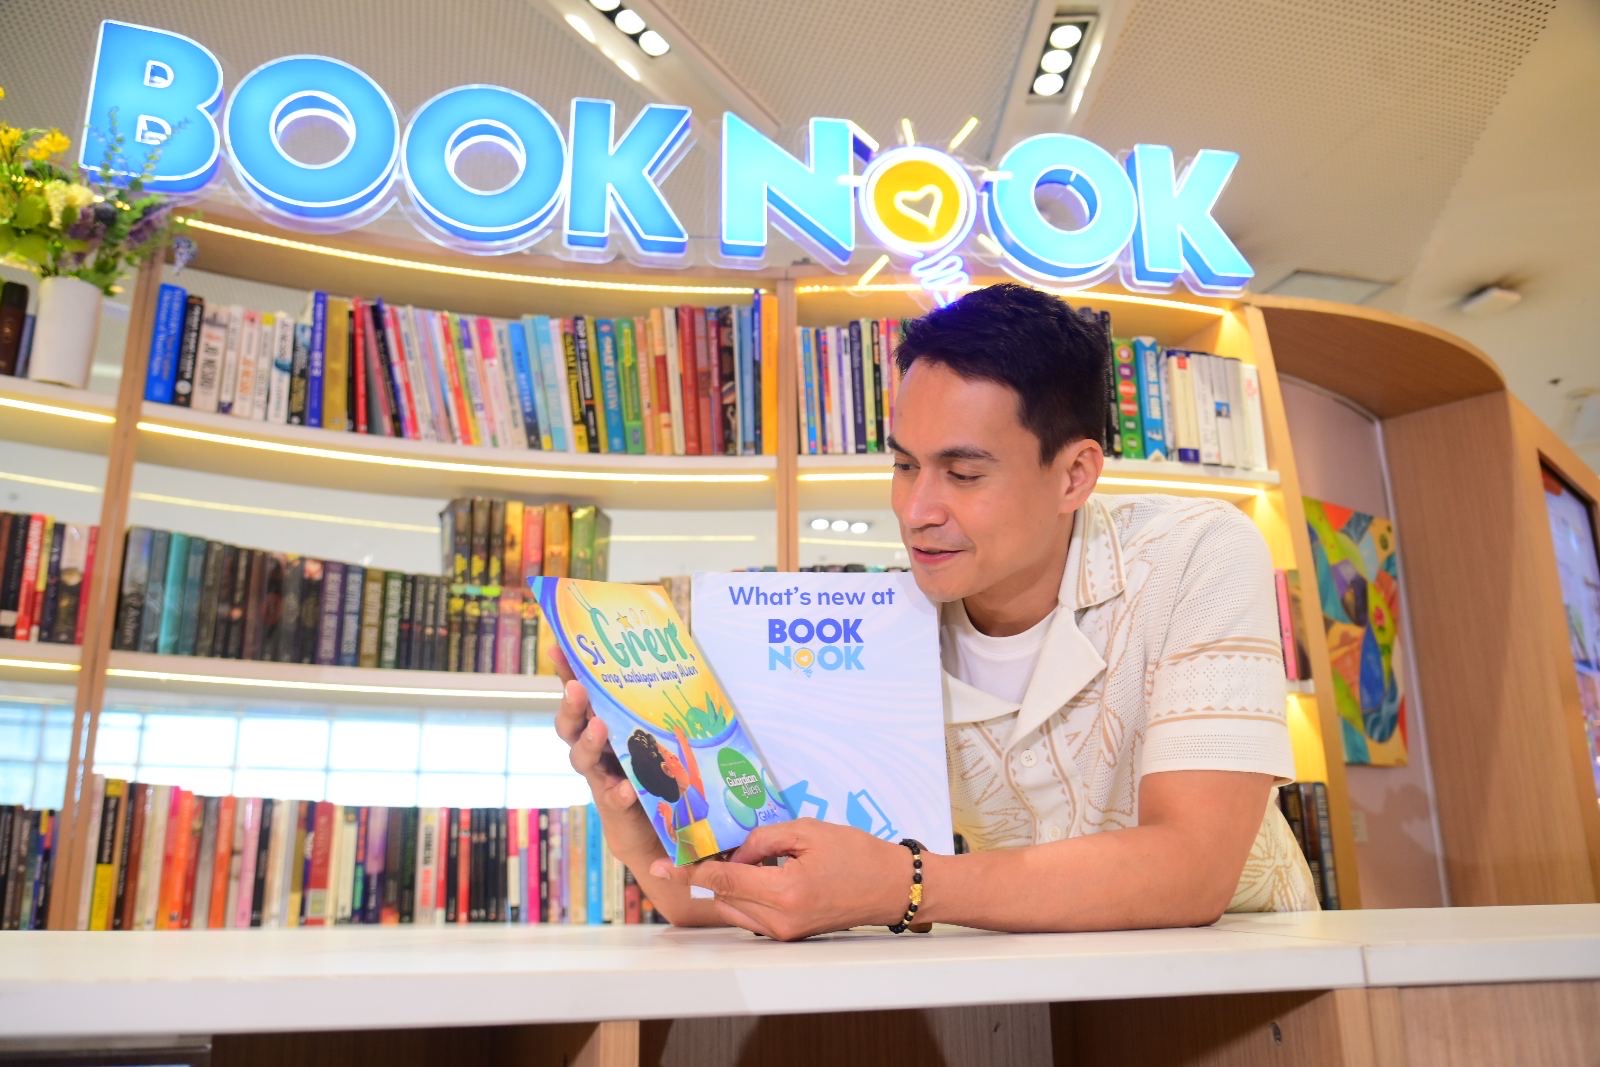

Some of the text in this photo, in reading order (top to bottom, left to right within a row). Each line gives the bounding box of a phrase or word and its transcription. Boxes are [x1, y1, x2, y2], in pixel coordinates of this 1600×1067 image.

[79, 19, 1256, 291] BOOK NOOK
[728, 585, 896, 606] What's new at
[768, 617, 865, 644] BOOK
[576, 634, 606, 666] Si
[768, 645, 866, 675] NOOK
[601, 673, 624, 689] ang
[655, 666, 682, 685] kong
[676, 663, 699, 678] Alien
[725, 773, 758, 787] Guardian
[742, 783, 762, 798] Alien
[758, 805, 780, 822] GMA
